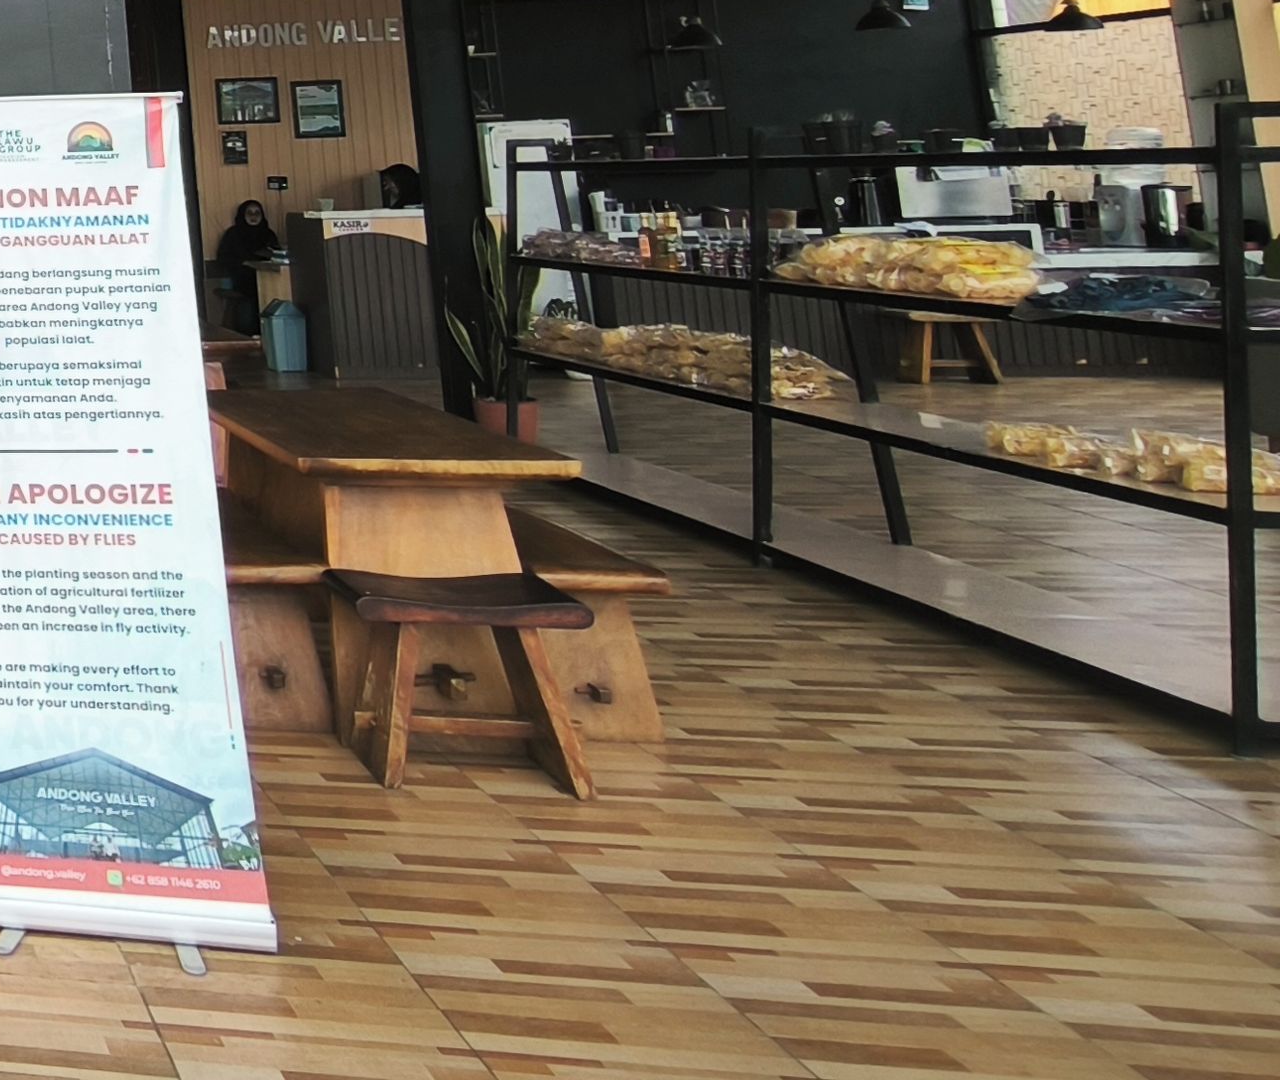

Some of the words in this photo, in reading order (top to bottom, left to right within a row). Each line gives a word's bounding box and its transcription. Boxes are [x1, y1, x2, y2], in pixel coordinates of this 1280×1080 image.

[208, 23, 308, 48] ANDONG
[317, 18, 401, 43] VALLE
[56, 186, 138, 206] MAAF
[0, 235, 96, 247] GANGGUAN
[100, 233, 148, 245] LALAT
[32, 268, 112, 280] berlangsung
[115, 266, 160, 276] musim
[66, 284, 104, 296] pupuk
[108, 282, 170, 293] pertanian
[30, 302, 79, 314] Andong
[82, 300, 120, 312] Valley
[124, 302, 157, 312] yang
[50, 318, 143, 329] meningkatnya
[5, 335, 59, 348] populasi
[62, 335, 94, 344] lalat.
[63, 360, 142, 370] semaksimal
[16, 377, 52, 387] untuk
[56, 376, 90, 388] tetap
[92, 376, 150, 388] menjaga
[80, 392, 116, 403] Anda.
[33, 410, 61, 420] atas
[64, 409, 164, 422] pengertiannya.
[8, 484, 173, 505] APOLOGIZE
[34, 514, 172, 526] INCONVENIENCE
[68, 534, 90, 545] BY
[94, 534, 136, 546] FLIES
[2, 569, 22, 578] the
[25, 570, 80, 582] planting
[82, 572, 130, 580] season
[132, 570, 158, 580] and
[160, 571, 183, 581] the
[35, 586, 48, 596] of
[50, 588, 128, 600] agricultural
[130, 588, 184, 598] fertilizer
[2, 604, 22, 614] the
[26, 604, 76, 616] Andong
[80, 605, 120, 617] Valley
[123, 607, 157, 617] area,
[160, 607, 196, 616] there
[22, 623, 38, 632] an
[42, 622, 98, 633] increase
[100, 622, 113, 633] in
[116, 623, 132, 635] fly
[136, 624, 190, 637] activity.
[5, 663, 26, 672] are
[30, 662, 80, 675] making
[83, 665, 120, 677] every
[123, 665, 160, 676] effort
[162, 667, 176, 676] to
[44, 682, 73, 692] your
[77, 682, 134, 693] comfort.
[137, 684, 178, 694] Thank
[17, 696, 34, 707] for
[38, 699, 66, 710] your
[70, 699, 174, 714] understanding.
[36, 787, 103, 804] ANDONG
[105, 793, 156, 808] VALLEY
